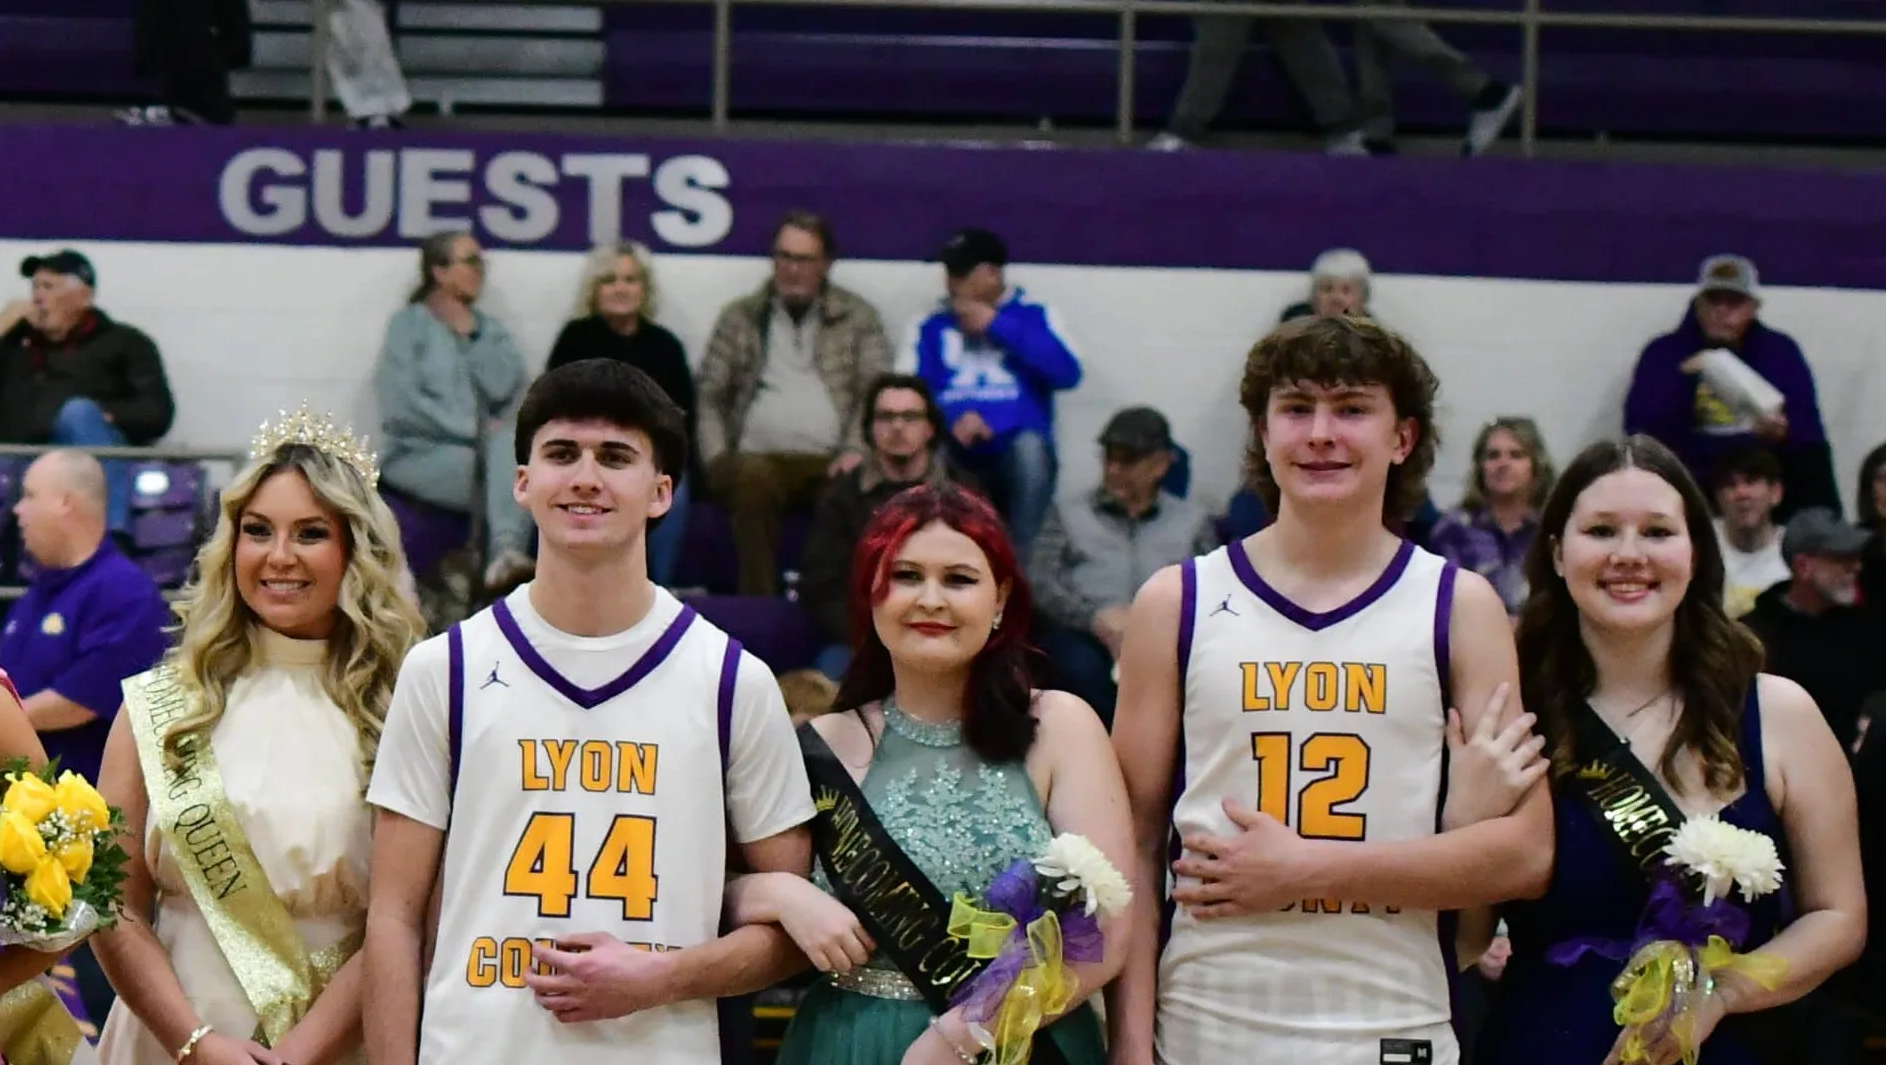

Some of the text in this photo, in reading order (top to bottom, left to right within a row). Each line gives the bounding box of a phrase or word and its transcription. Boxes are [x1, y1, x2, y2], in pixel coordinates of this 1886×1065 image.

[219, 147, 733, 249] GUESTS
[1239, 661, 1387, 714] LYON
[517, 738, 659, 796] LYON
[1251, 732, 1371, 842] 12
[174, 803, 248, 900] QUEEN
[502, 811, 659, 922] 44
